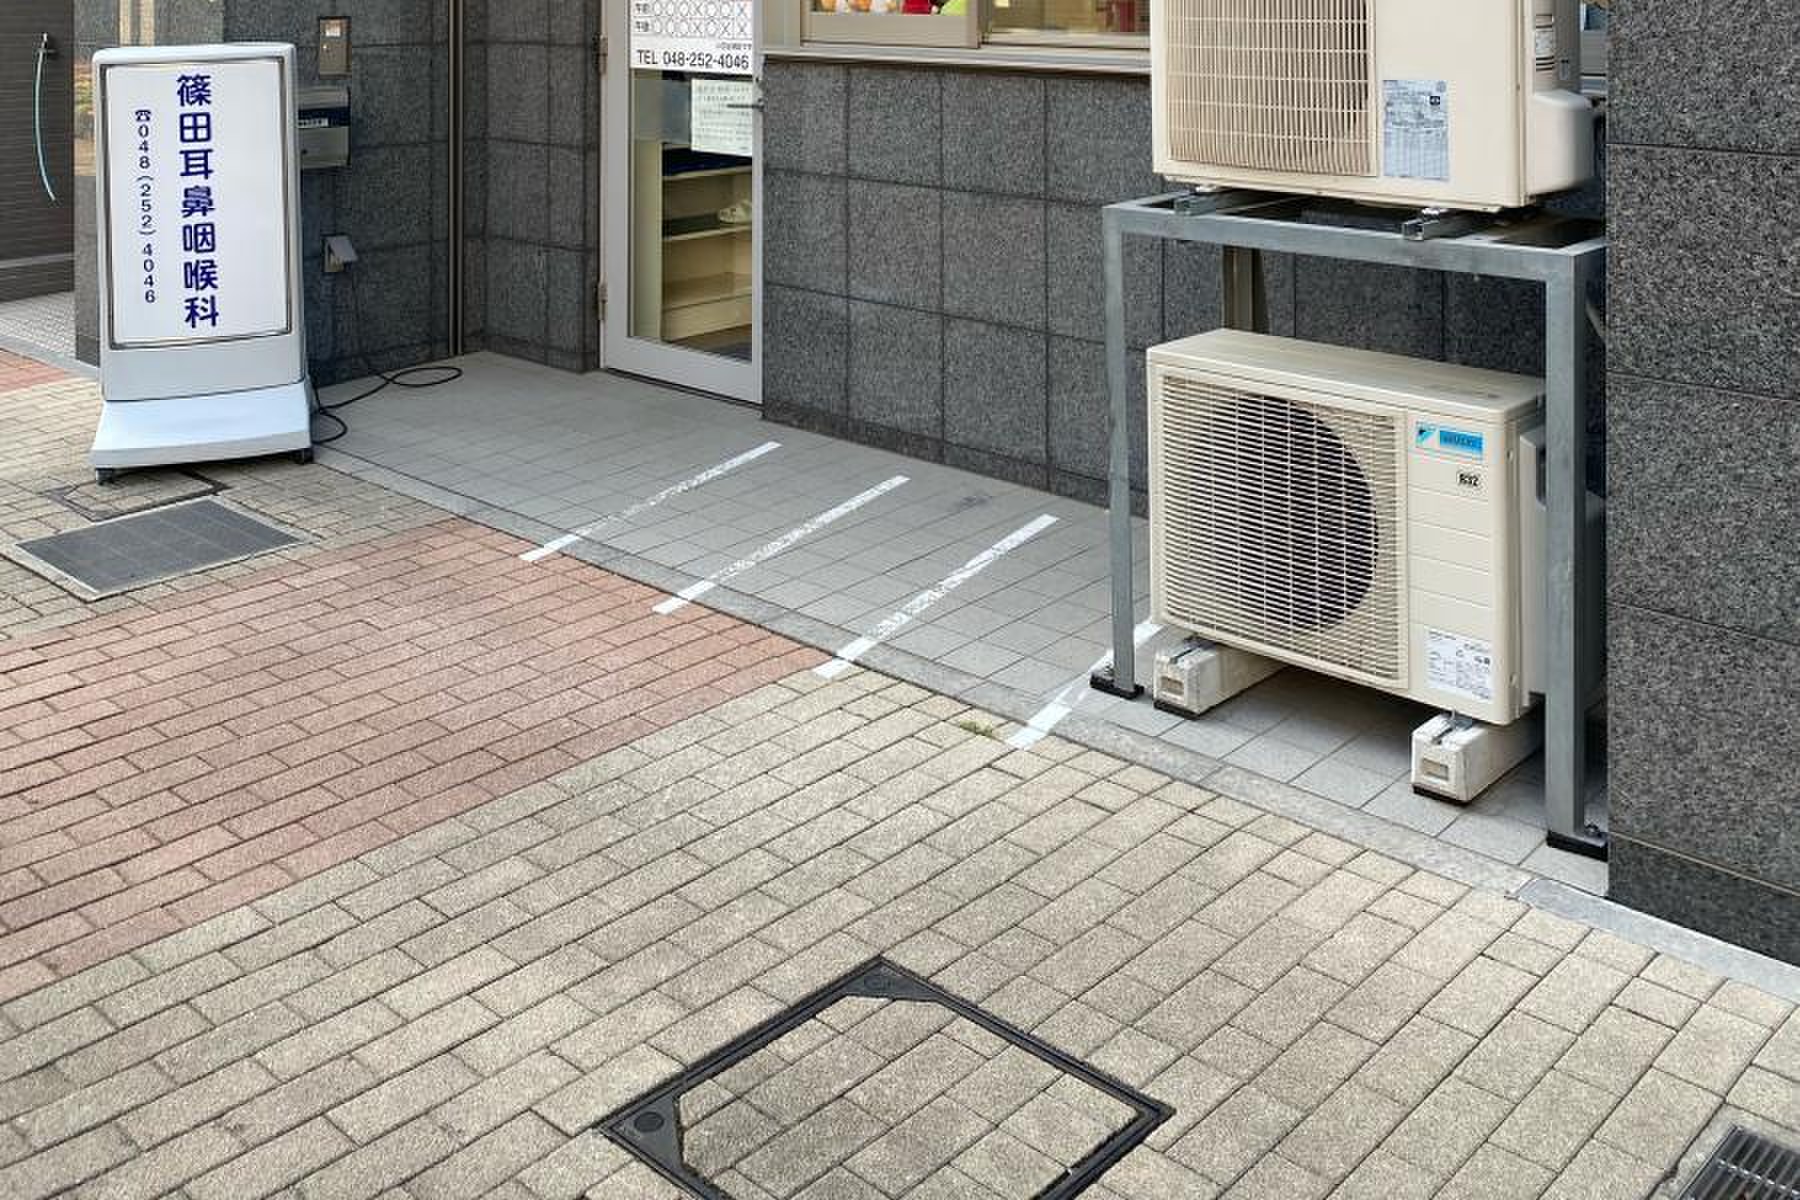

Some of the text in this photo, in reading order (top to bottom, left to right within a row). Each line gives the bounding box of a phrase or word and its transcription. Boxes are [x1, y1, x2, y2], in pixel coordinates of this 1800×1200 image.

[637, 49, 658, 65] TEL
[176, 74, 219, 329] 篠田耳鼻咽喉科
